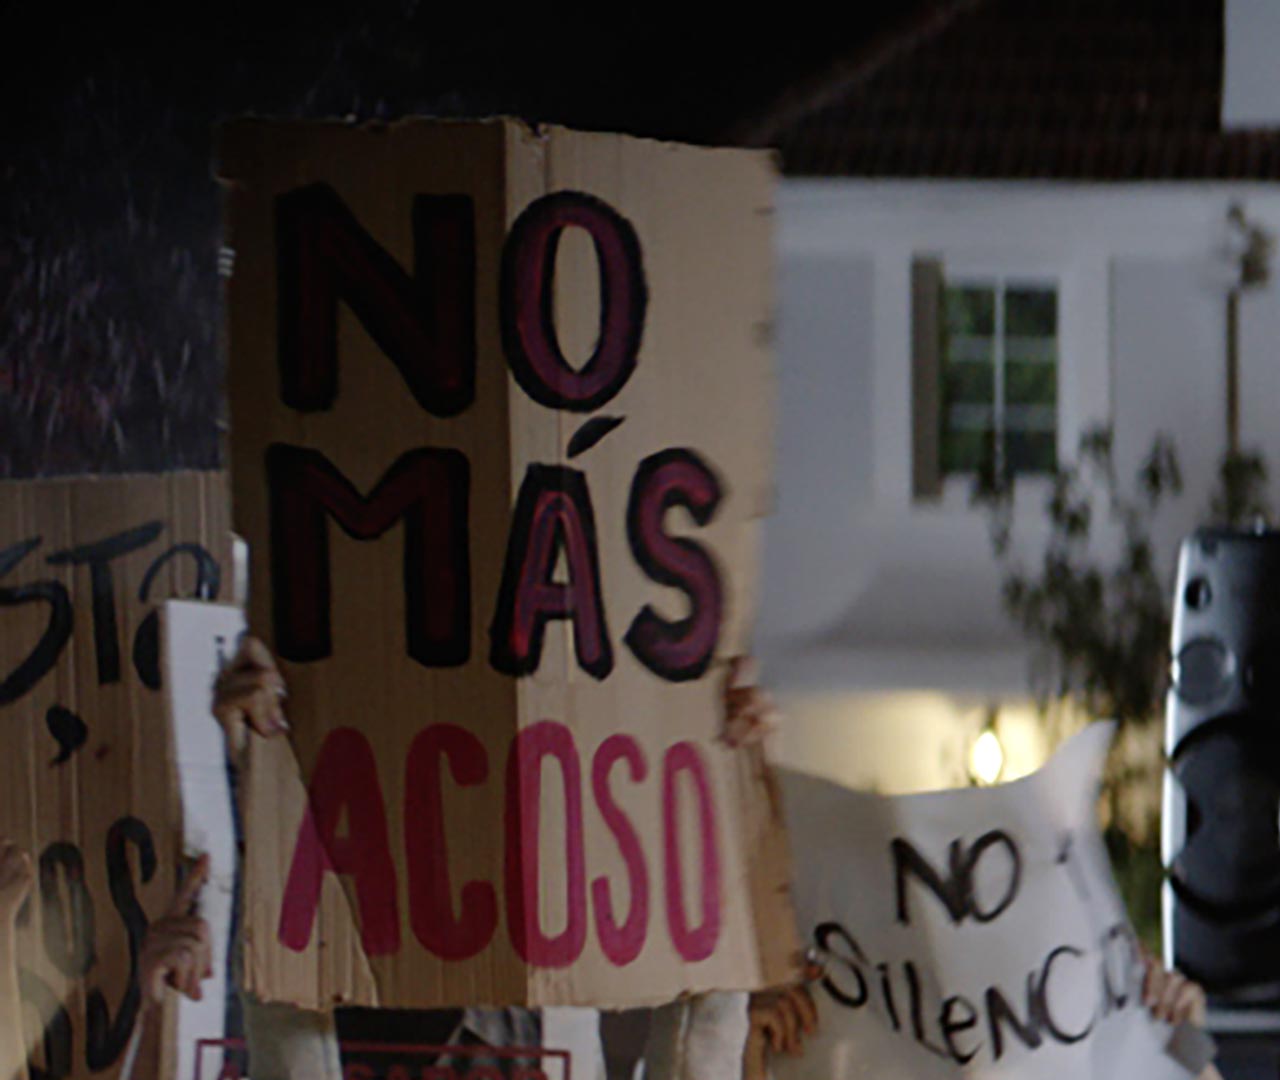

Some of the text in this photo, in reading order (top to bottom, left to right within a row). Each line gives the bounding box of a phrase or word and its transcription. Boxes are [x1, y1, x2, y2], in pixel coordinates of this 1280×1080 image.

[276, 182, 648, 416] NO
[265, 417, 724, 681] MÁS
[278, 721, 720, 968] ACOSO
[890, 829, 1022, 926] NO
